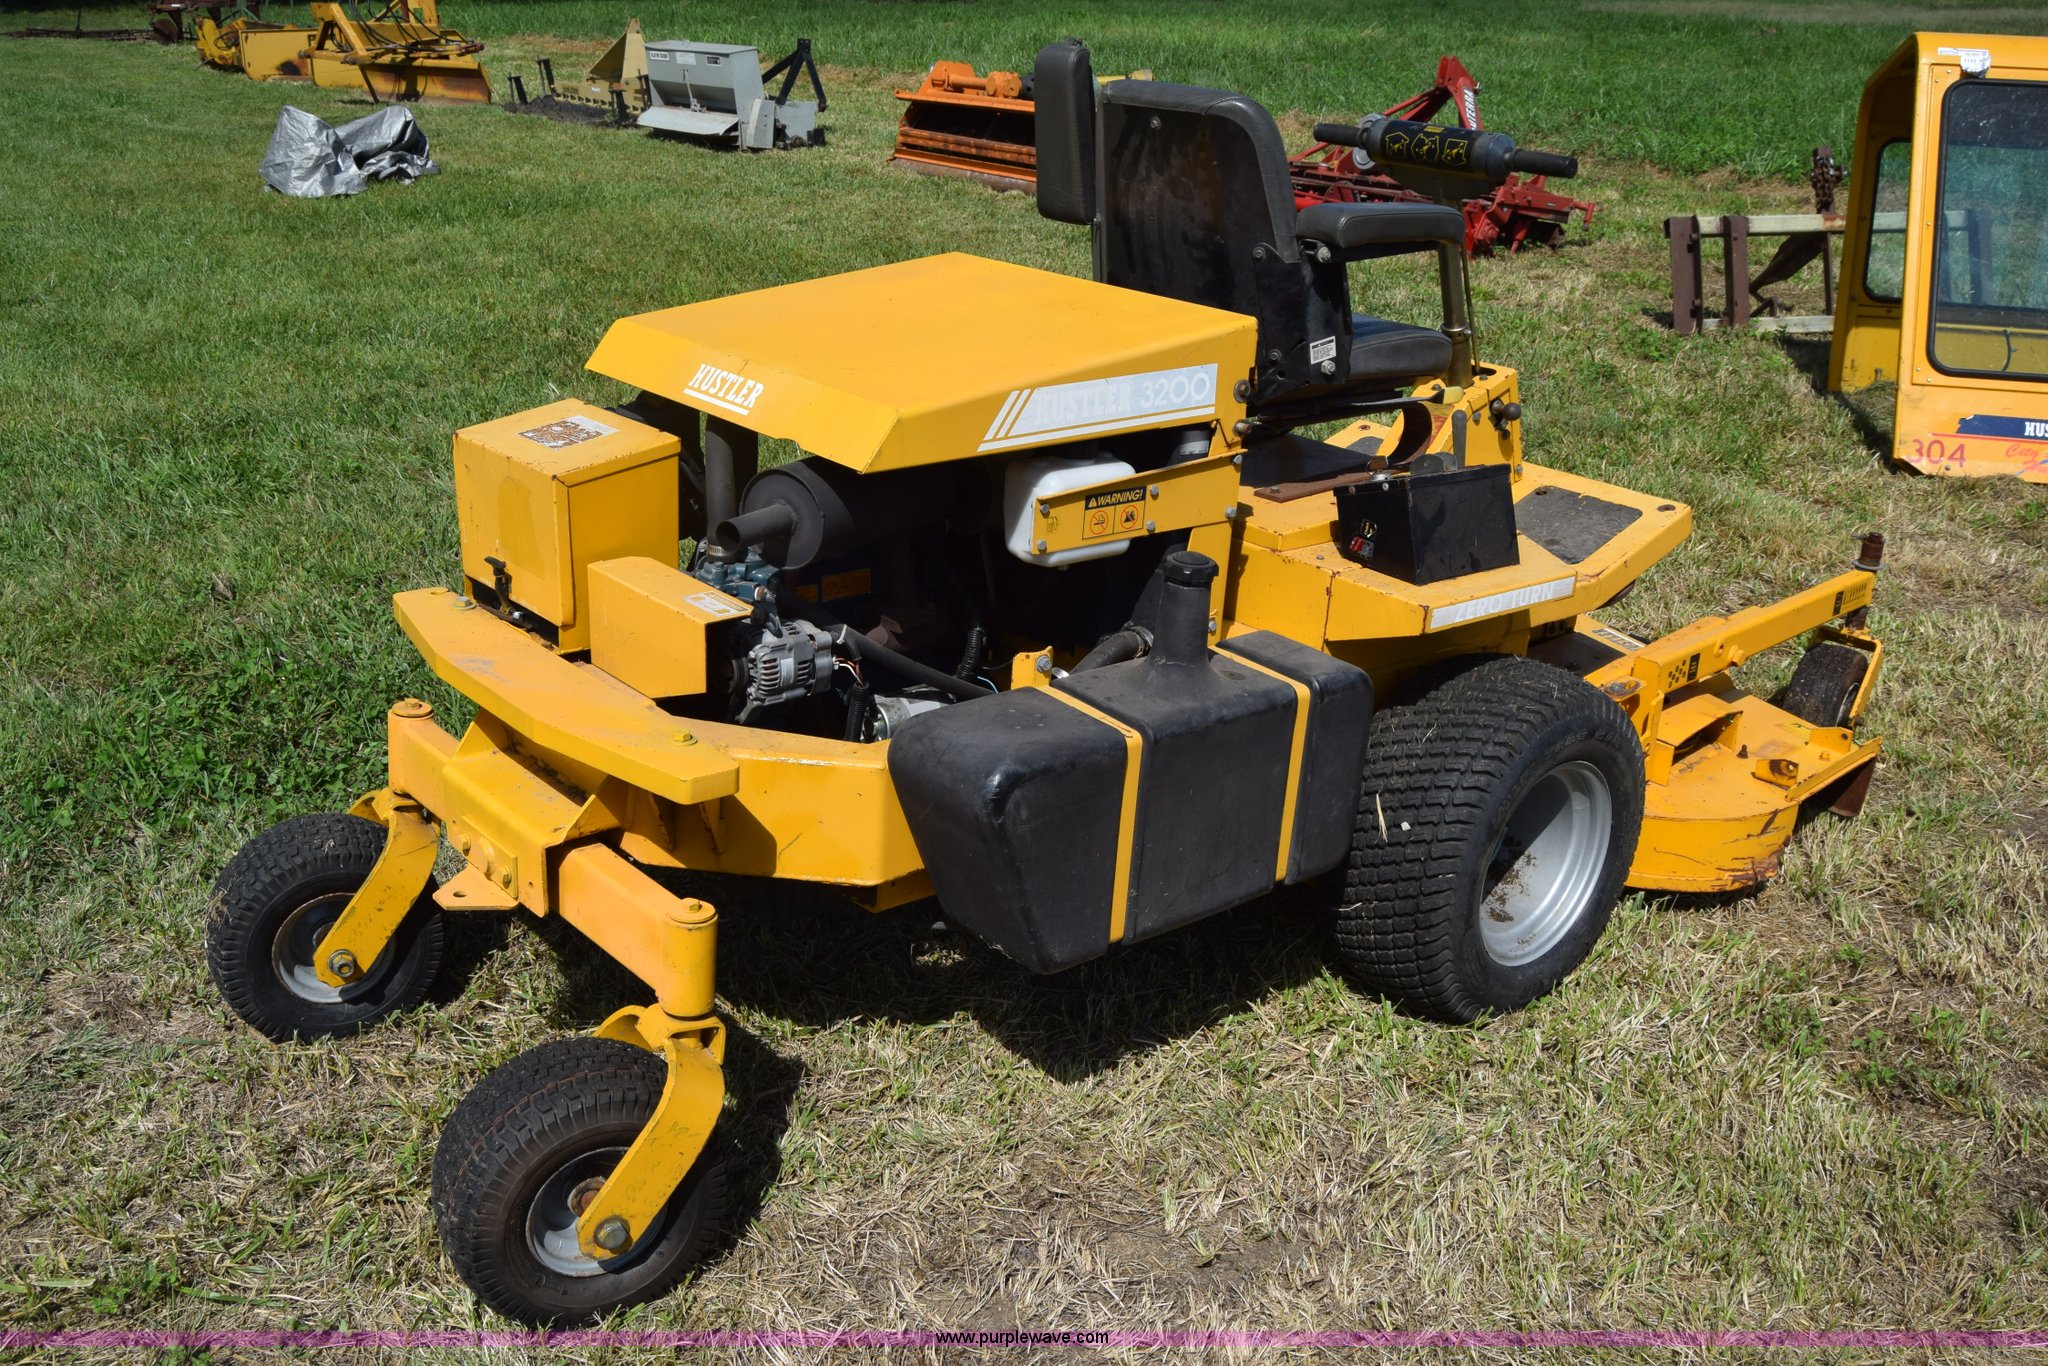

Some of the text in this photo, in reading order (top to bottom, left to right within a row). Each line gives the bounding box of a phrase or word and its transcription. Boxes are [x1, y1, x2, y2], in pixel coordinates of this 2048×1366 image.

[688, 363, 764, 408] HUSTLER
[1035, 372, 1210, 424] HUSTLER 3200
[1906, 438, 1967, 468] 304
[1097, 489, 1143, 506] WARNING!
[1454, 582, 1554, 622] ZERO TURN
